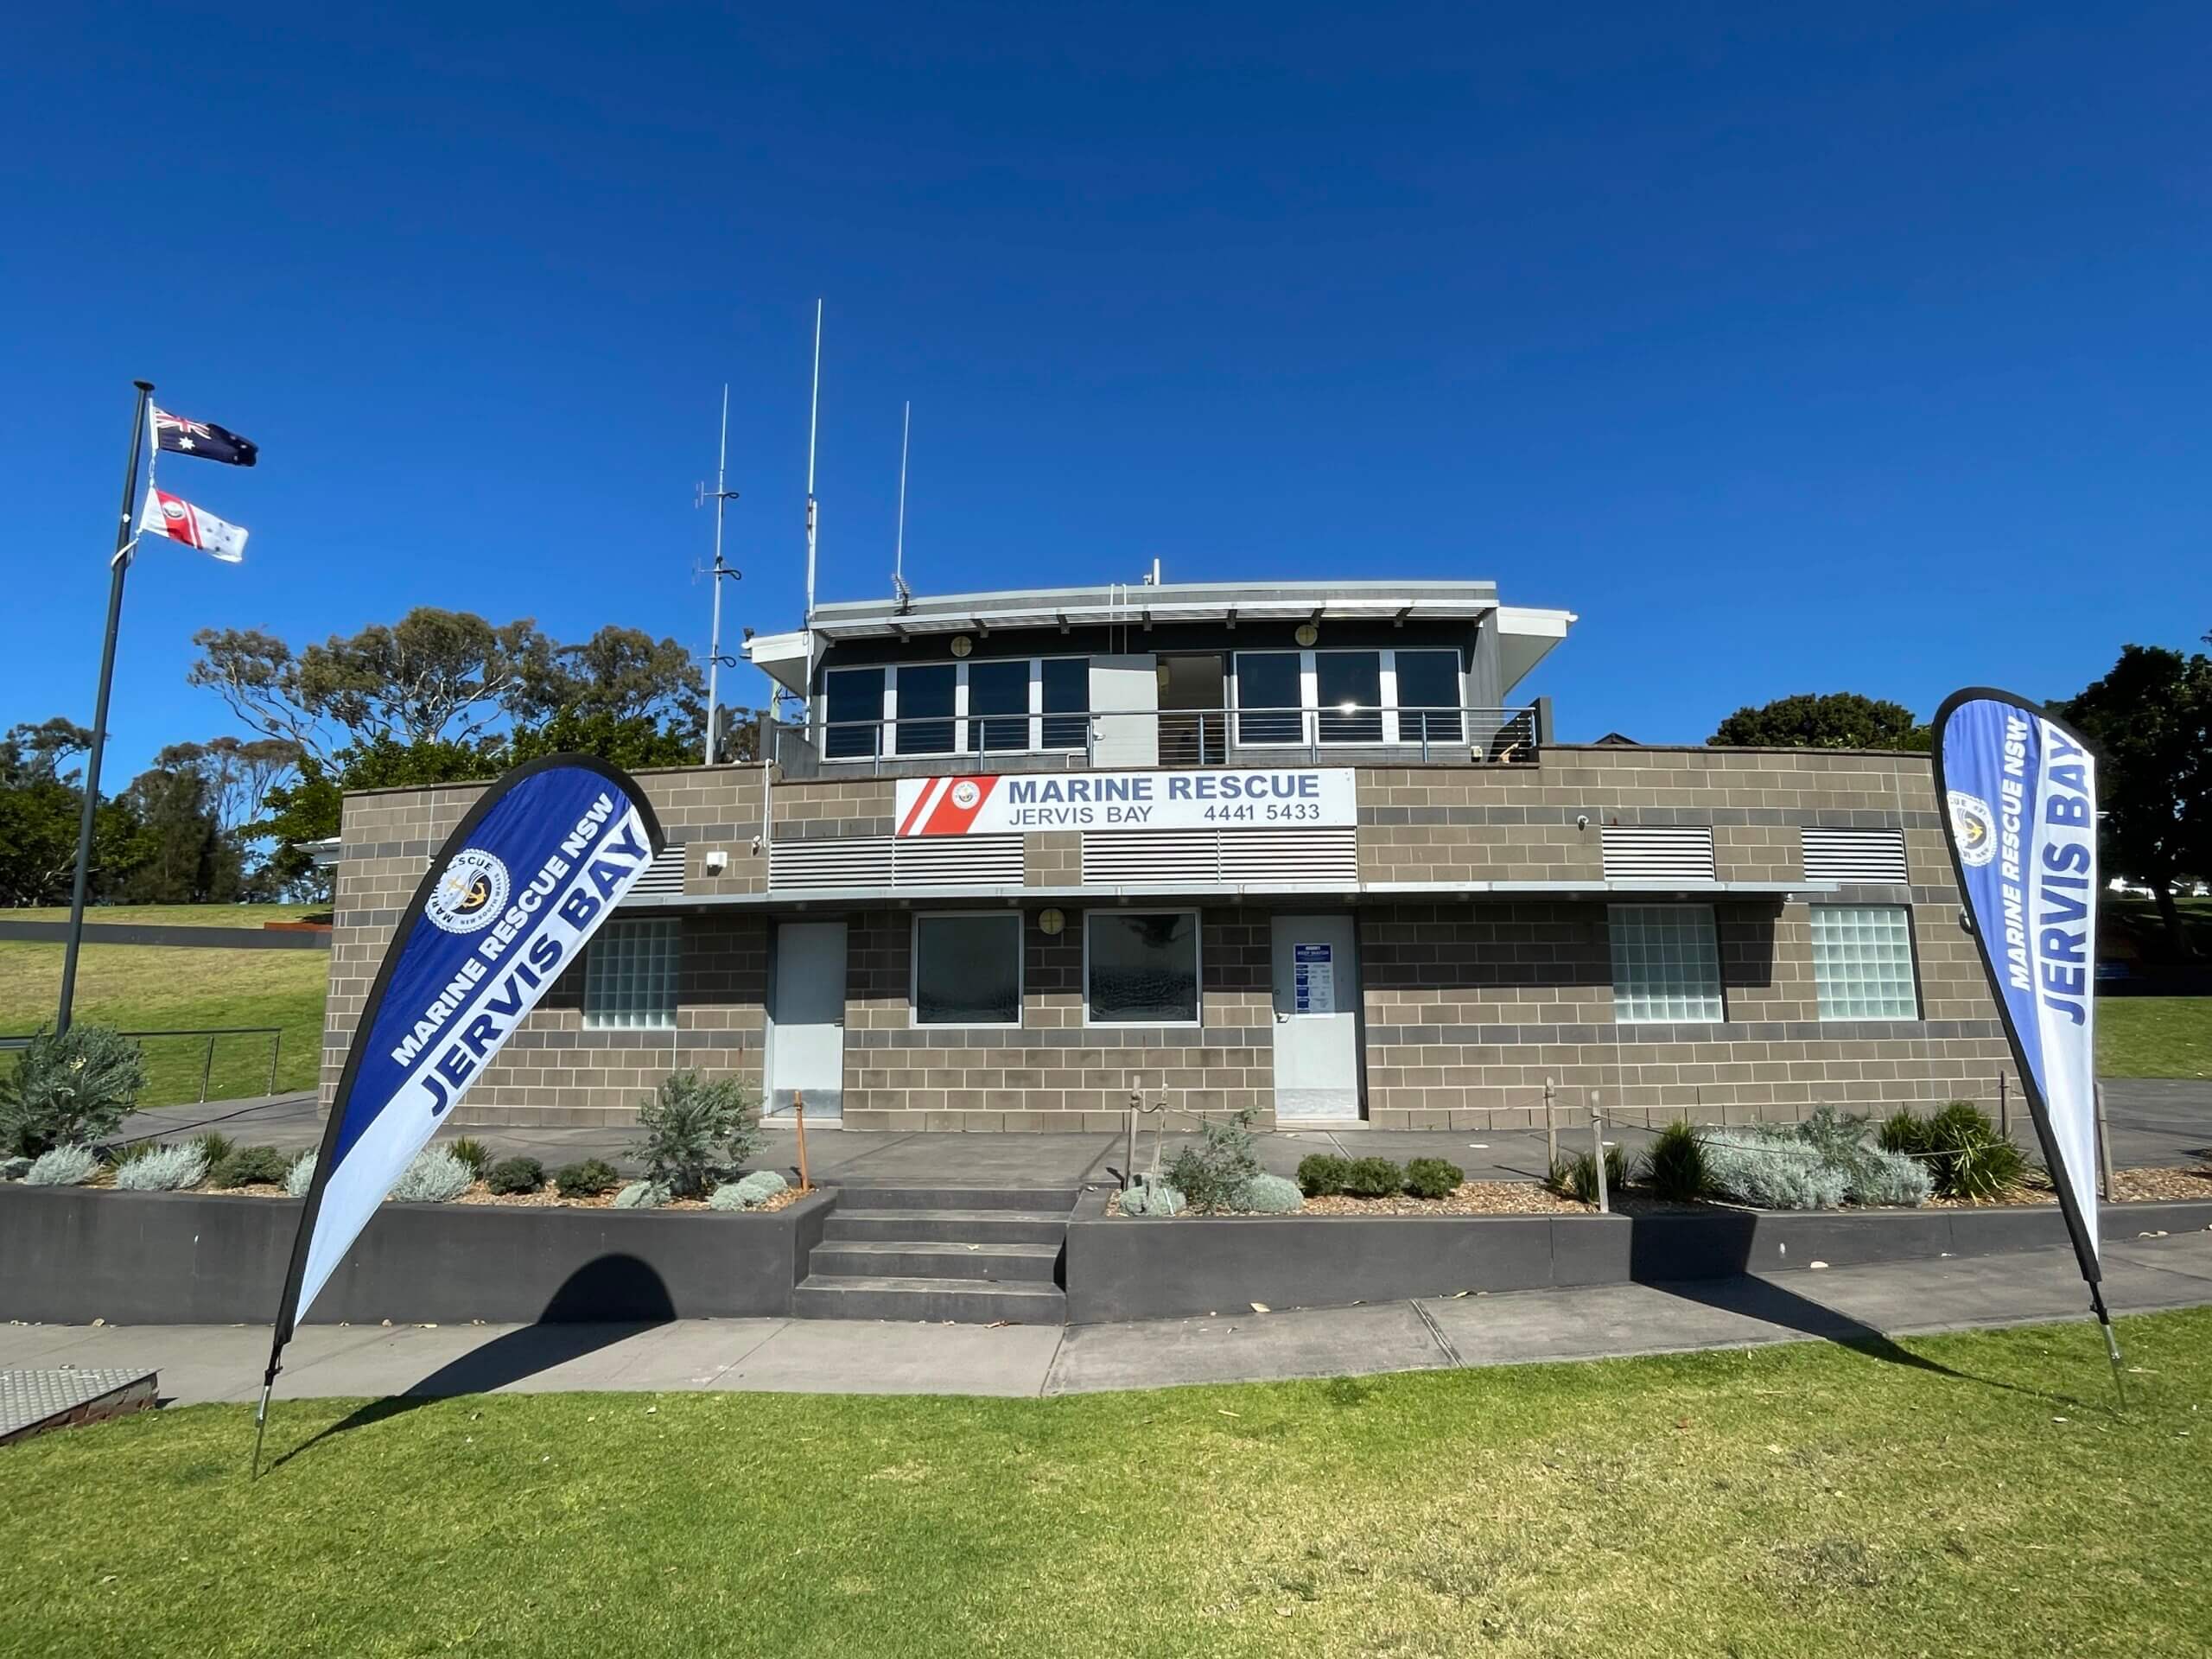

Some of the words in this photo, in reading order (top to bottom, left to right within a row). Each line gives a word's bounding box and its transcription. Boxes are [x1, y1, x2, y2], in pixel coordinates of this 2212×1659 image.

[1009, 778, 1153, 804] MARINE
[1168, 775, 1320, 800] RESCUE
[2003, 715, 2028, 777] NSW
[2045, 729, 2091, 829] BAY
[1009, 806, 1094, 825] JERVIS
[1107, 805, 1153, 823] BAY
[1204, 804, 1254, 821] 4441
[1267, 804, 1320, 820] 5433
[2001, 779, 2024, 882] RESCUE
[391, 957, 490, 1068] MARINE
[478, 855, 570, 962] RESCUE
[561, 792, 613, 859] NSW
[421, 932, 563, 1117] JERVIS
[557, 822, 648, 932] BAY
[2002, 884, 2031, 992] MARINE
[2039, 842, 2091, 1027] JERVIS
